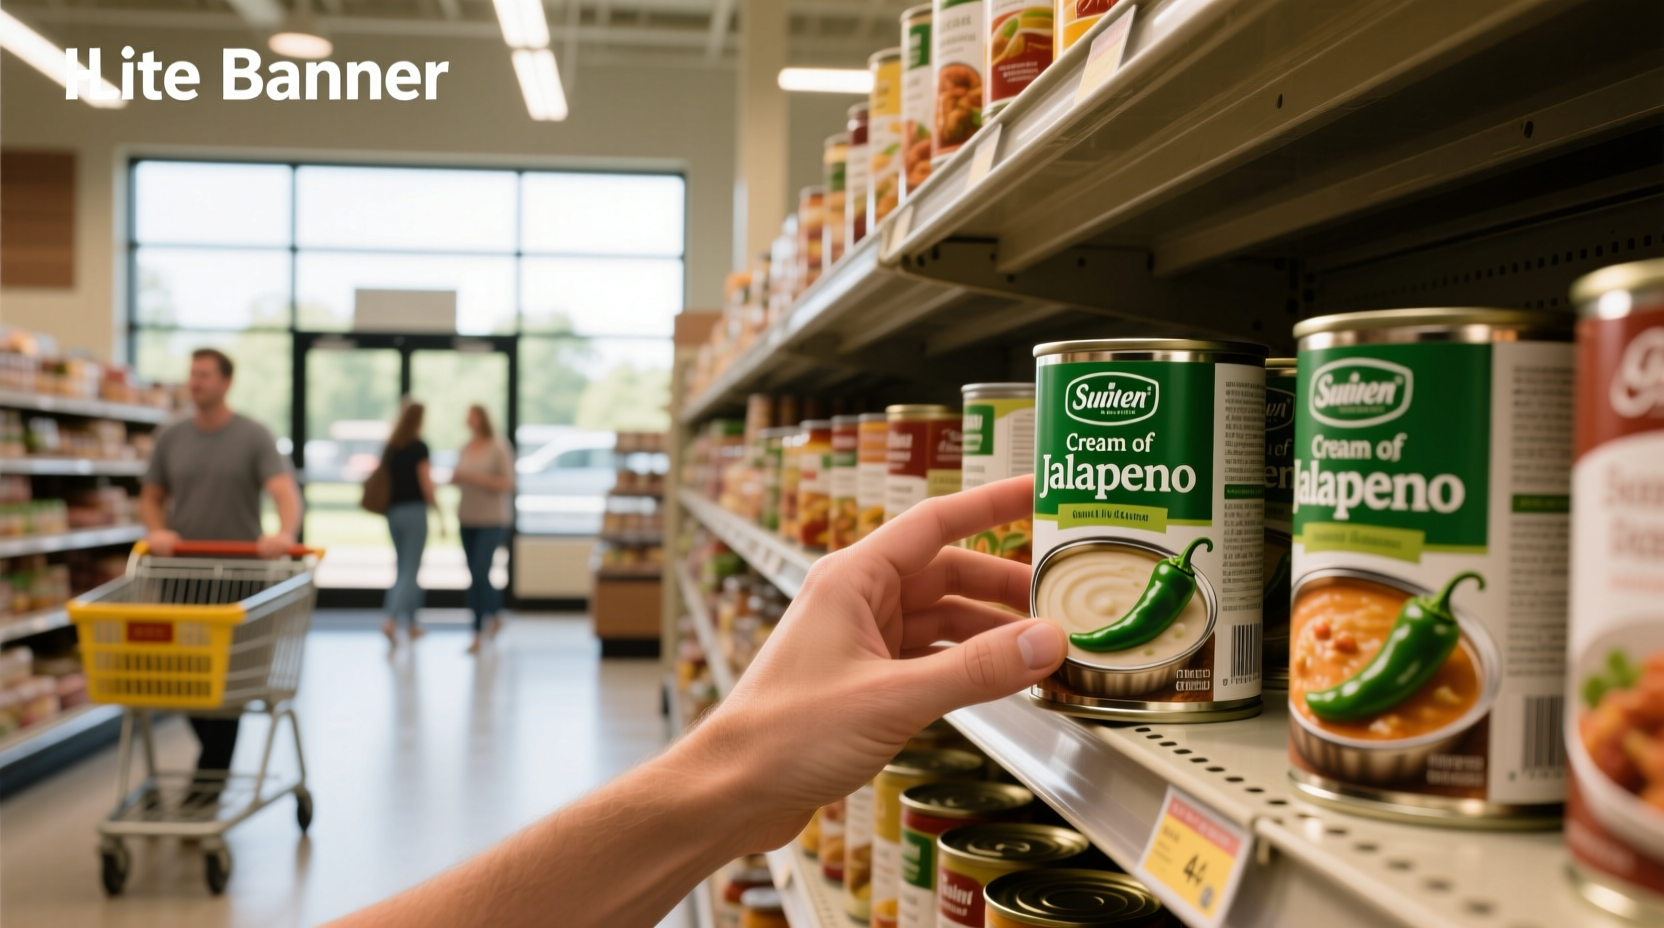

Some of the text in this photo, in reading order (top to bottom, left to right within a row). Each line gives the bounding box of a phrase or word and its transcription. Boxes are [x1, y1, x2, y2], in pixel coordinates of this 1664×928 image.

[1066, 432, 1156, 453] Cream of
[1310, 432, 1408, 462] Cream of
[1039, 453, 1197, 500] Jalapeno
